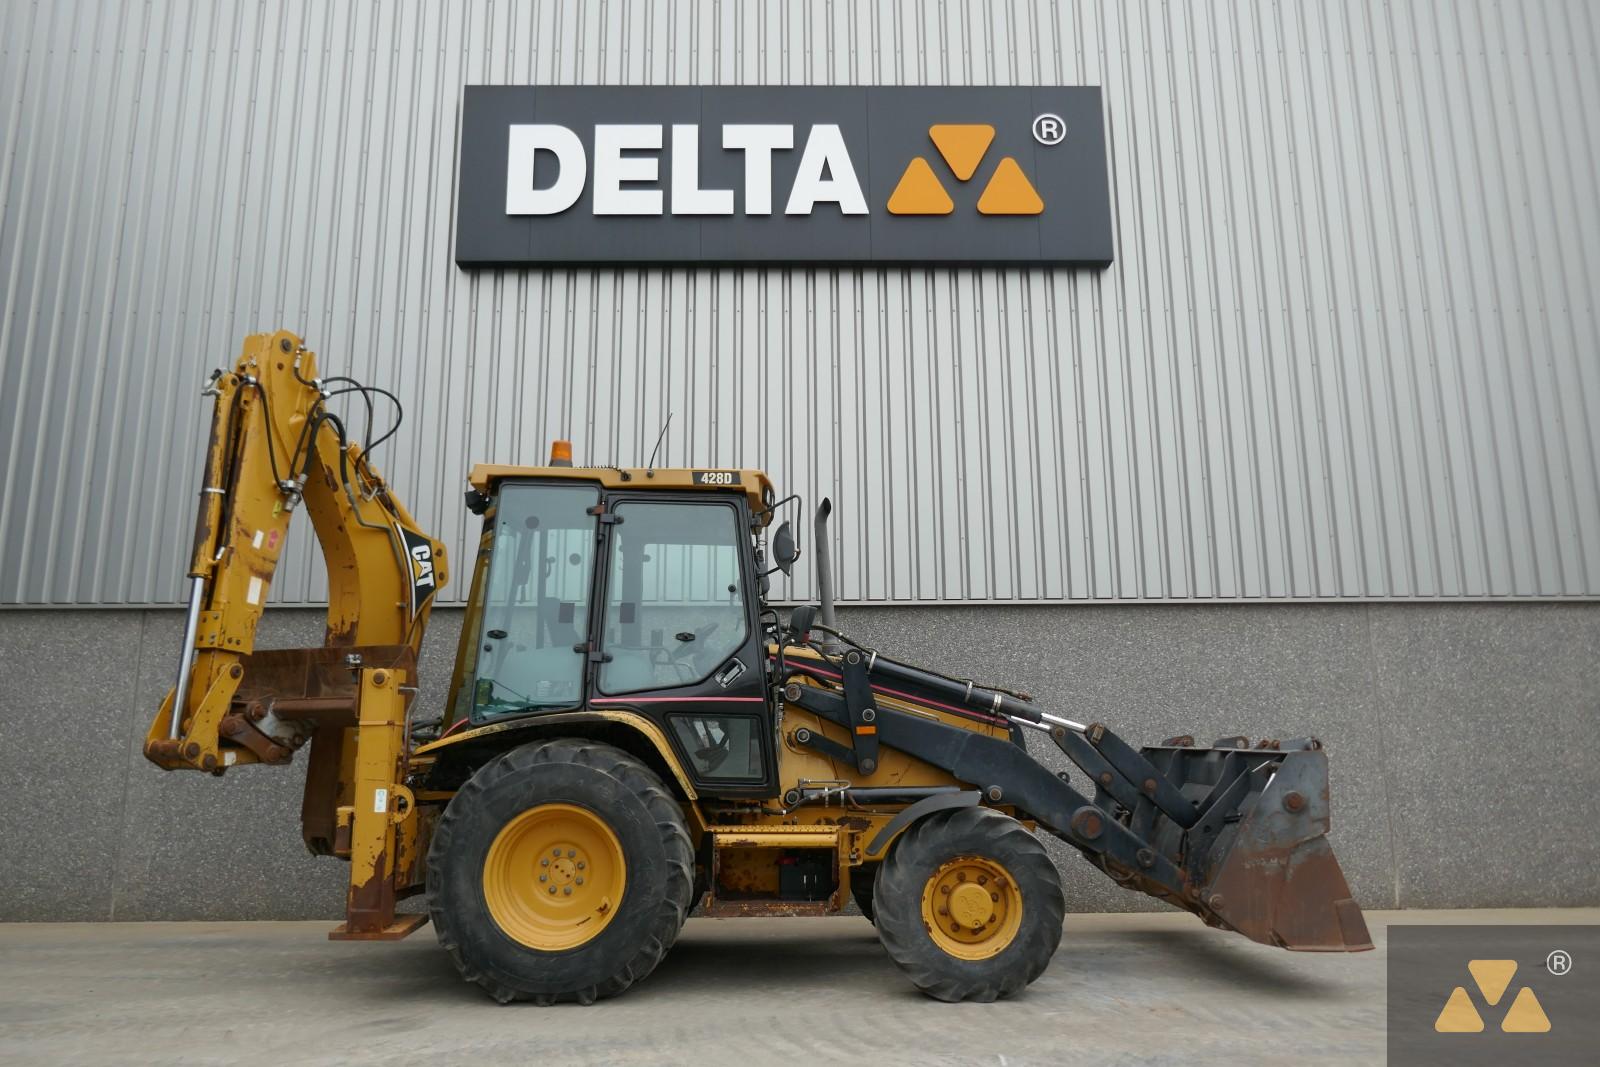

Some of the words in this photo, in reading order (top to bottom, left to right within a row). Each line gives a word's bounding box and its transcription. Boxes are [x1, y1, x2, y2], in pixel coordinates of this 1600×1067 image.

[505, 123, 870, 216] DELTA
[701, 472, 733, 485] 428D
[411, 544, 435, 587] CAT
